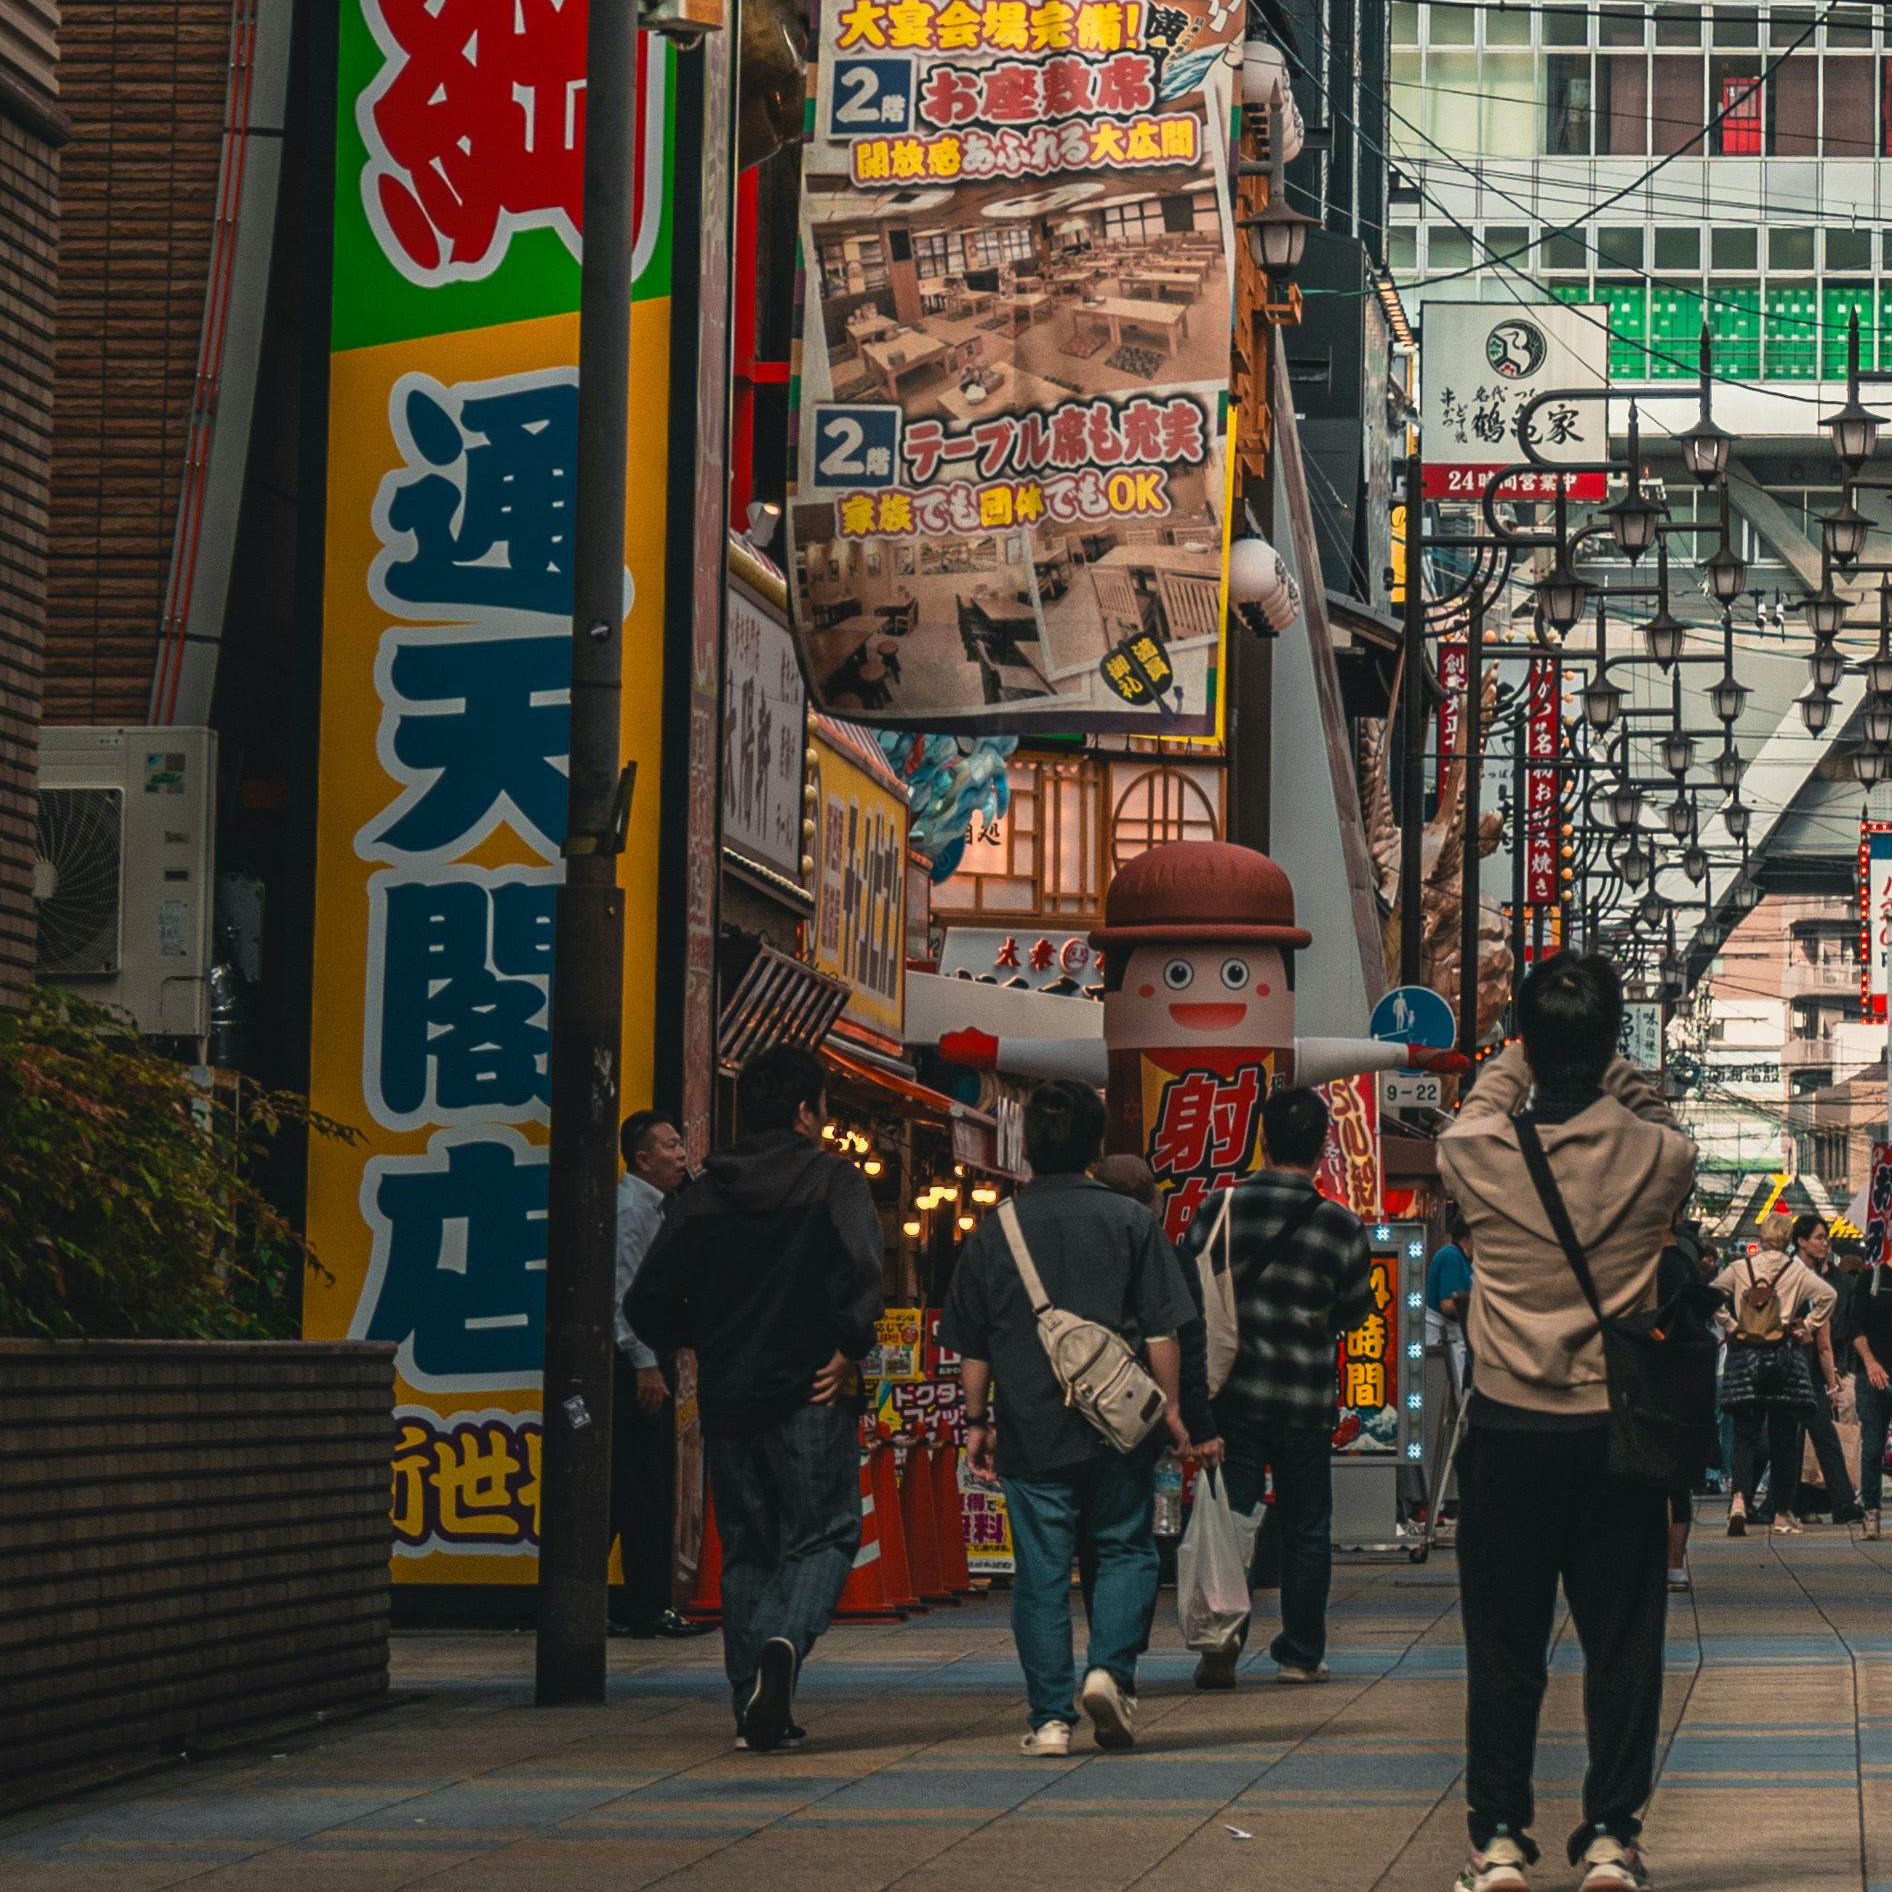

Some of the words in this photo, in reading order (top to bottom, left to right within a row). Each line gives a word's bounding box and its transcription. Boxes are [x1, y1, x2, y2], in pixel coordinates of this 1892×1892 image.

[840, 2, 1140, 51] 大宴会場完備!
[833, 67, 904, 122] 2階
[922, 56, 1153, 119] お座敷席
[856, 121, 1194, 179] 開放感あふれる大広間
[819, 417, 890, 477] 2階
[905, 402, 1201, 479] テーブル席も充実
[840, 470, 1162, 535] 家族でも団体でもOK
[1386, 1083, 1437, 1102] 9-22
